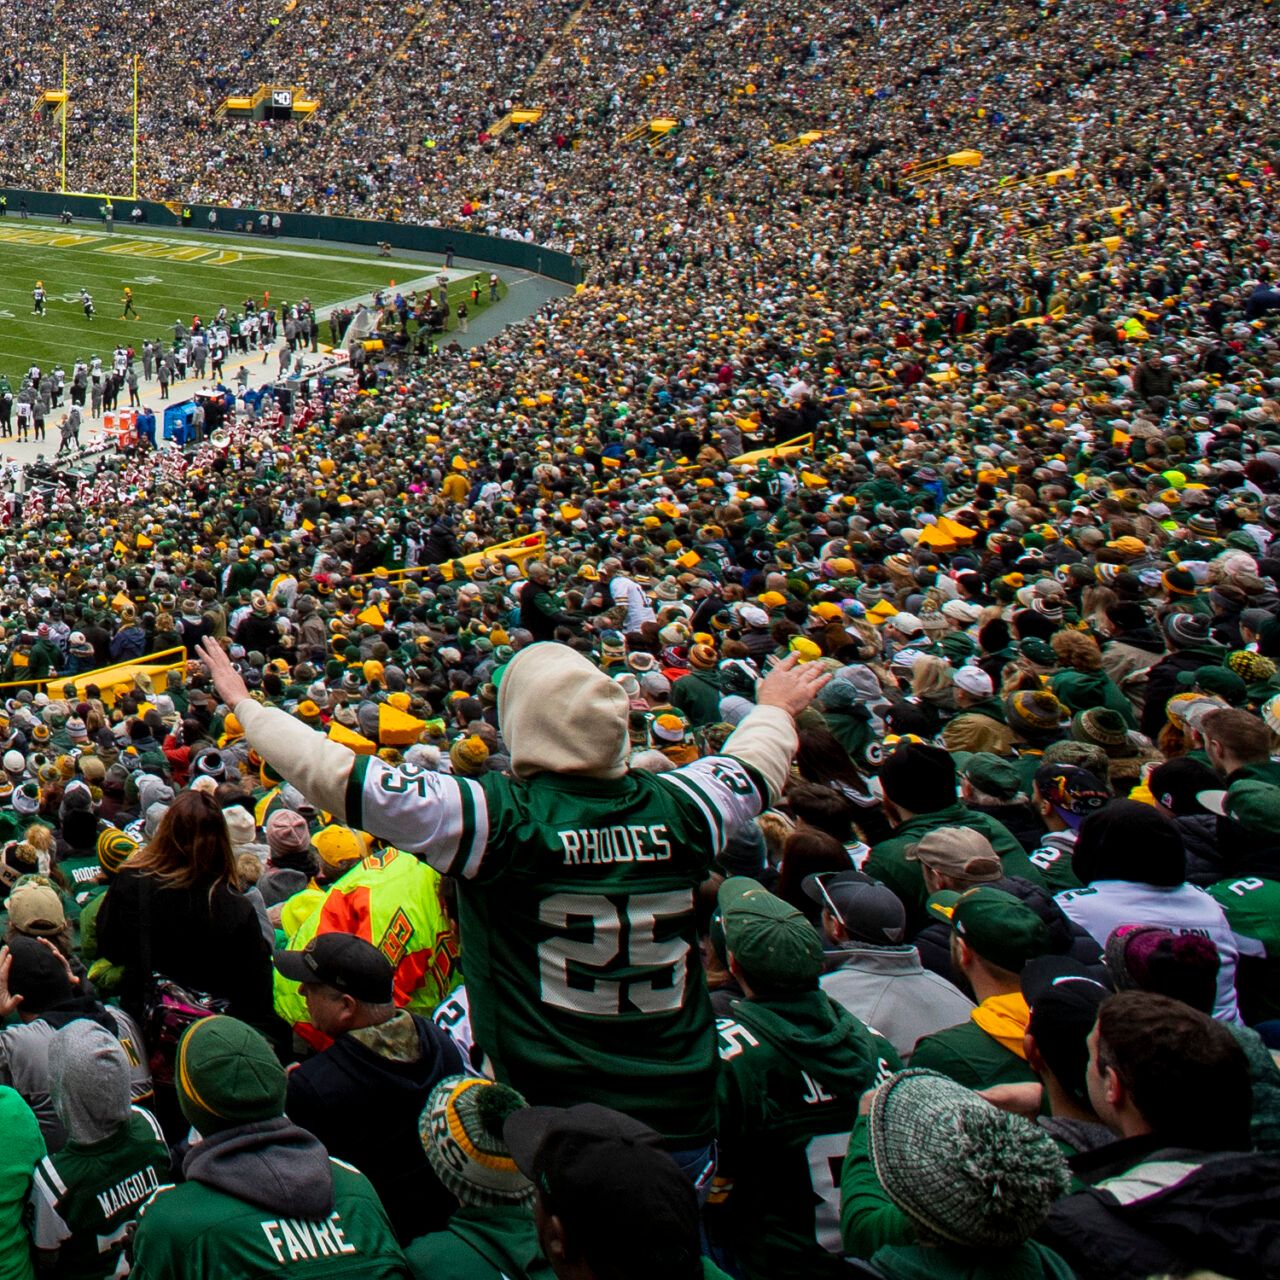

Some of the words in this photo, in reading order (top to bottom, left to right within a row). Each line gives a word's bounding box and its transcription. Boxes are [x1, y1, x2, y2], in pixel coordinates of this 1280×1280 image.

[95, 239, 281, 265] BAY
[558, 823, 671, 865] RHODES
[537, 888, 696, 1017] 25
[96, 1165, 160, 1219] MANGOLD
[260, 1211, 356, 1264] FAVRE
